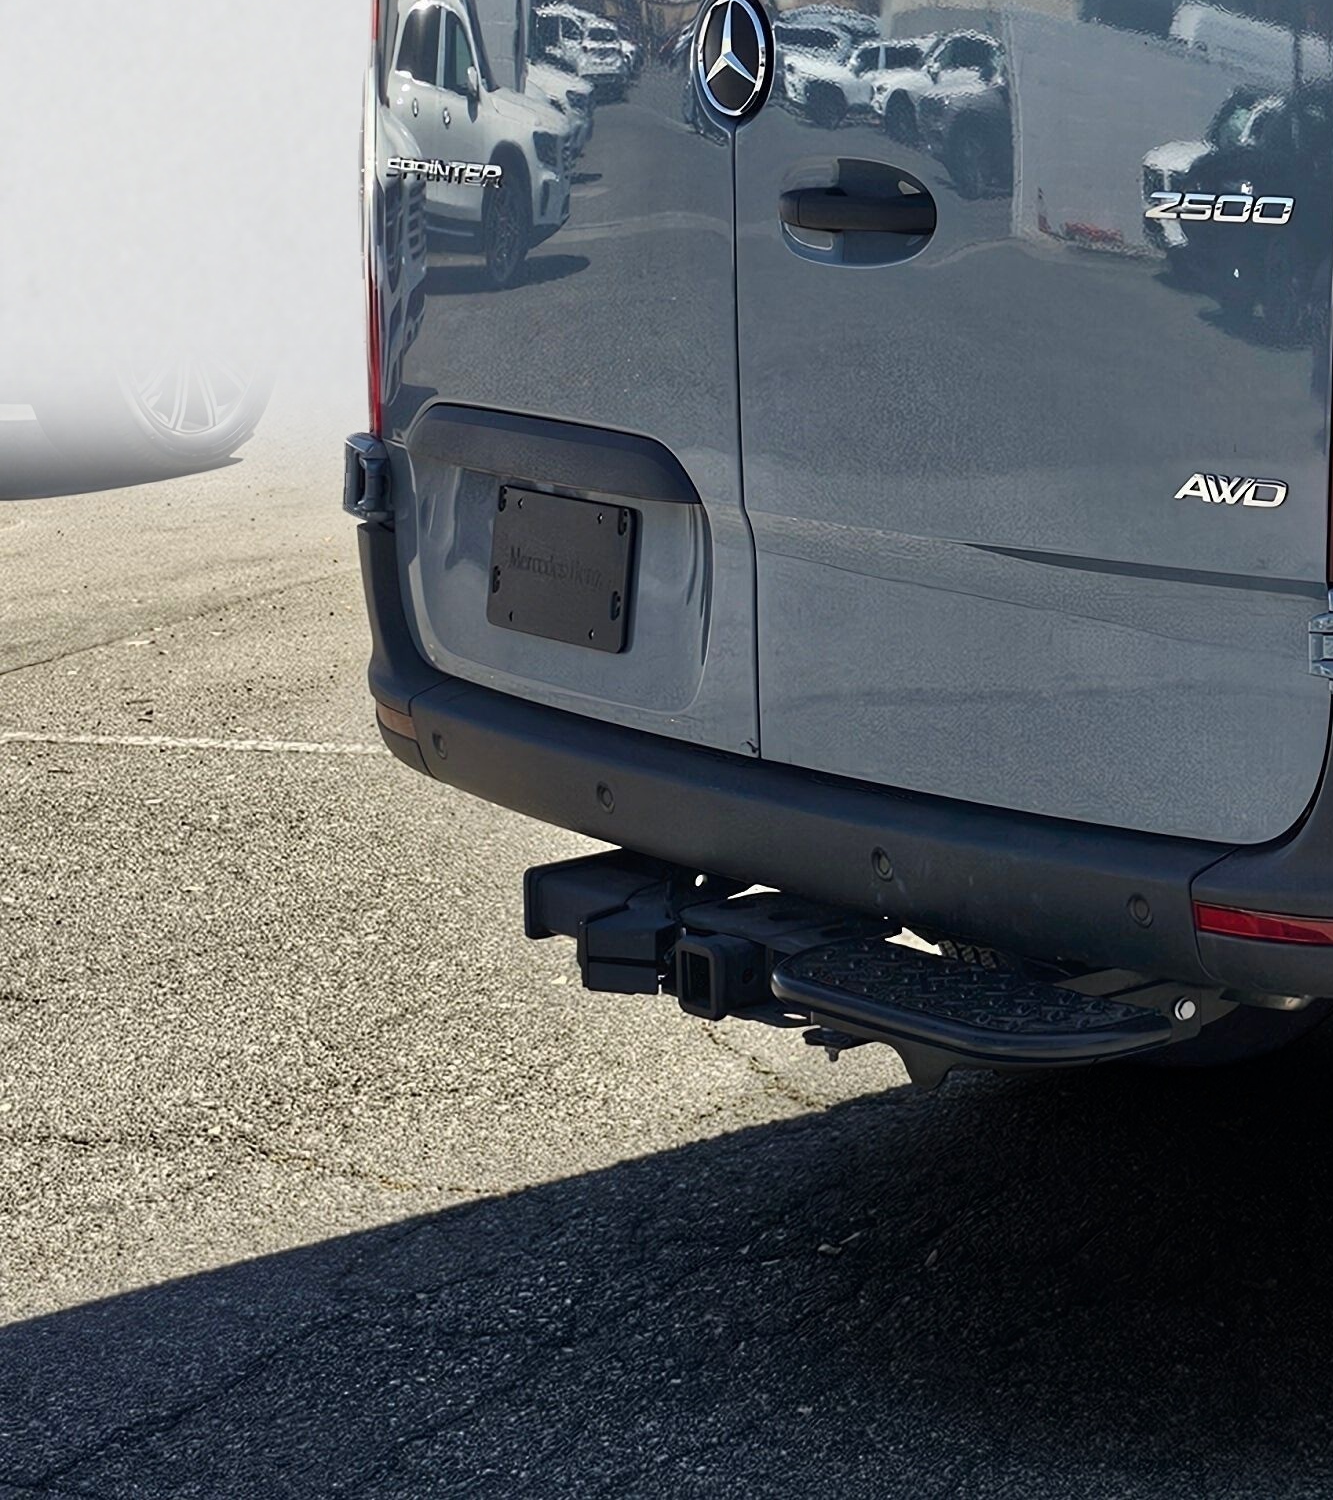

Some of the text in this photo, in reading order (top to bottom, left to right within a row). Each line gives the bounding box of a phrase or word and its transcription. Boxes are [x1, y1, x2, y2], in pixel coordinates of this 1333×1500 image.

[386, 156, 503, 189] SPRINTER
[1145, 191, 1296, 225] 2500
[1173, 472, 1289, 508] AWD
